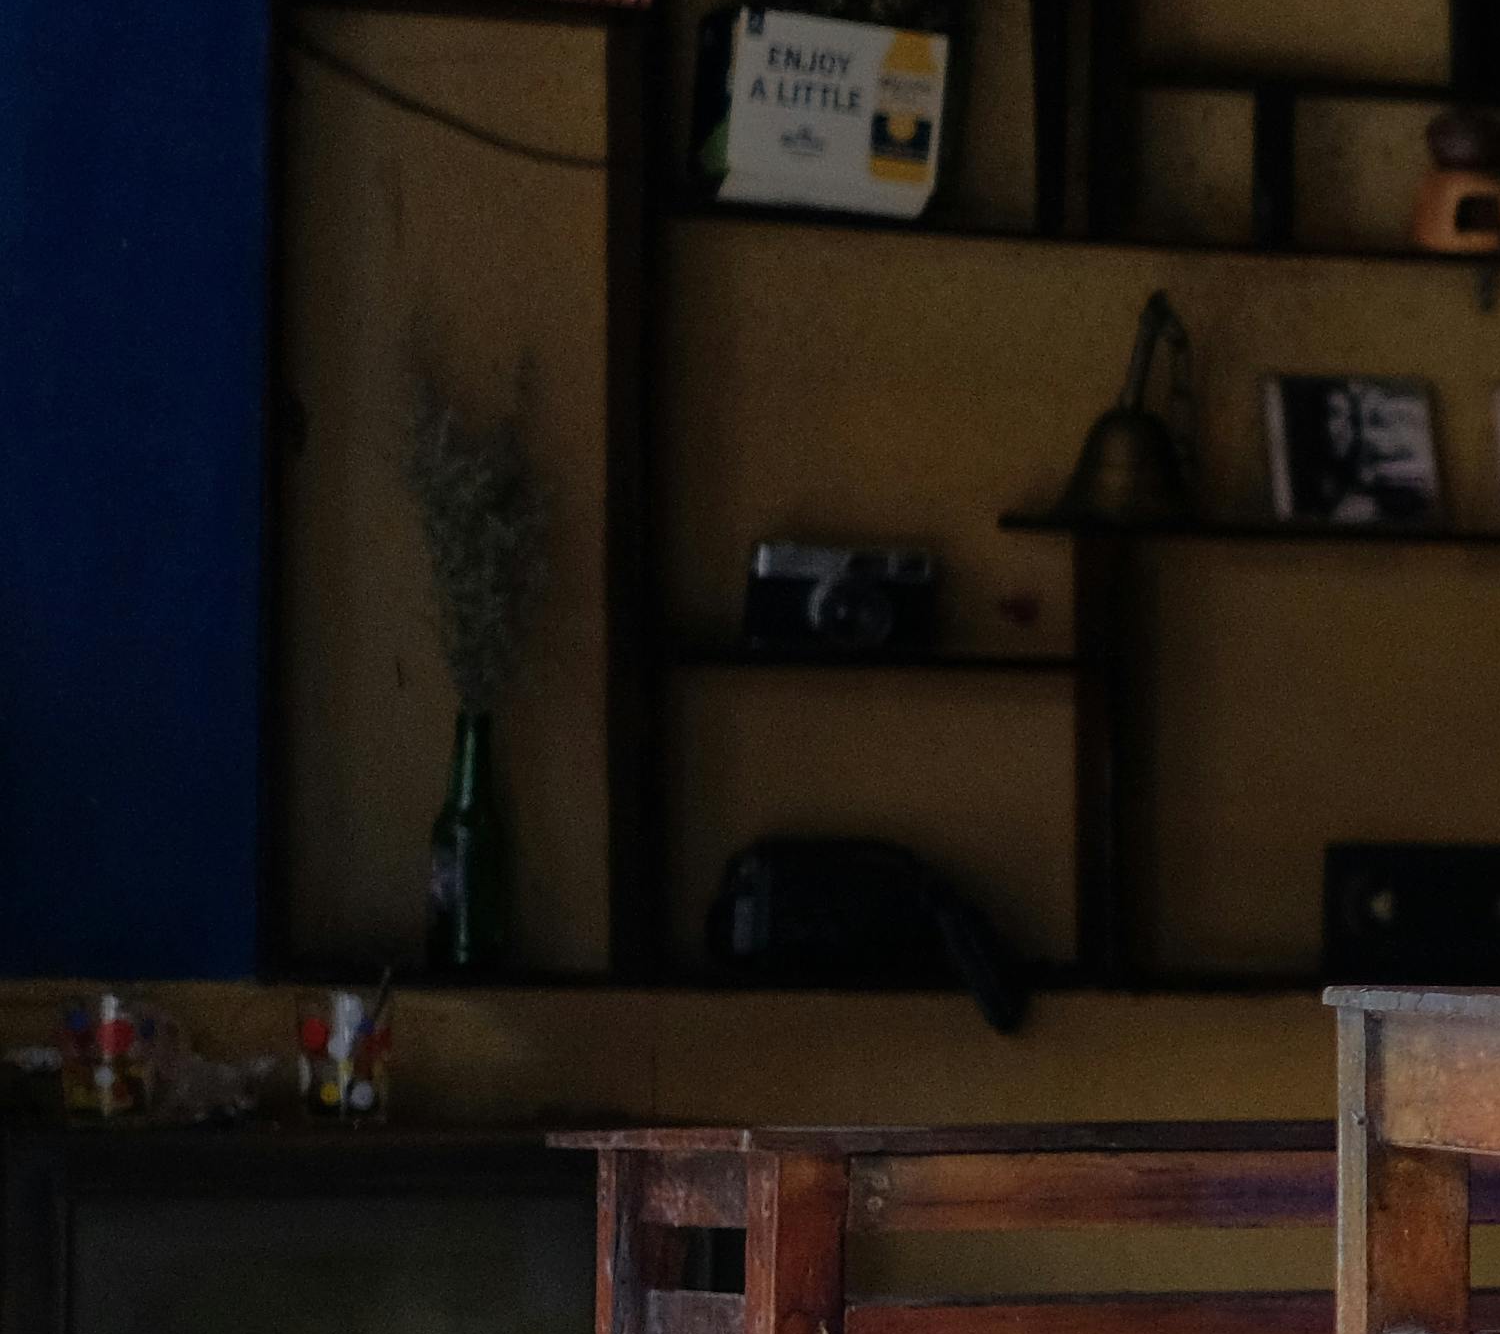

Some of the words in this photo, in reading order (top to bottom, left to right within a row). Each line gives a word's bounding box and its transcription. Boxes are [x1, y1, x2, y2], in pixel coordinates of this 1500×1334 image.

[768, 47, 850, 75] ENJOY
[749, 77, 767, 103] A
[777, 81, 861, 112] LITTLE
